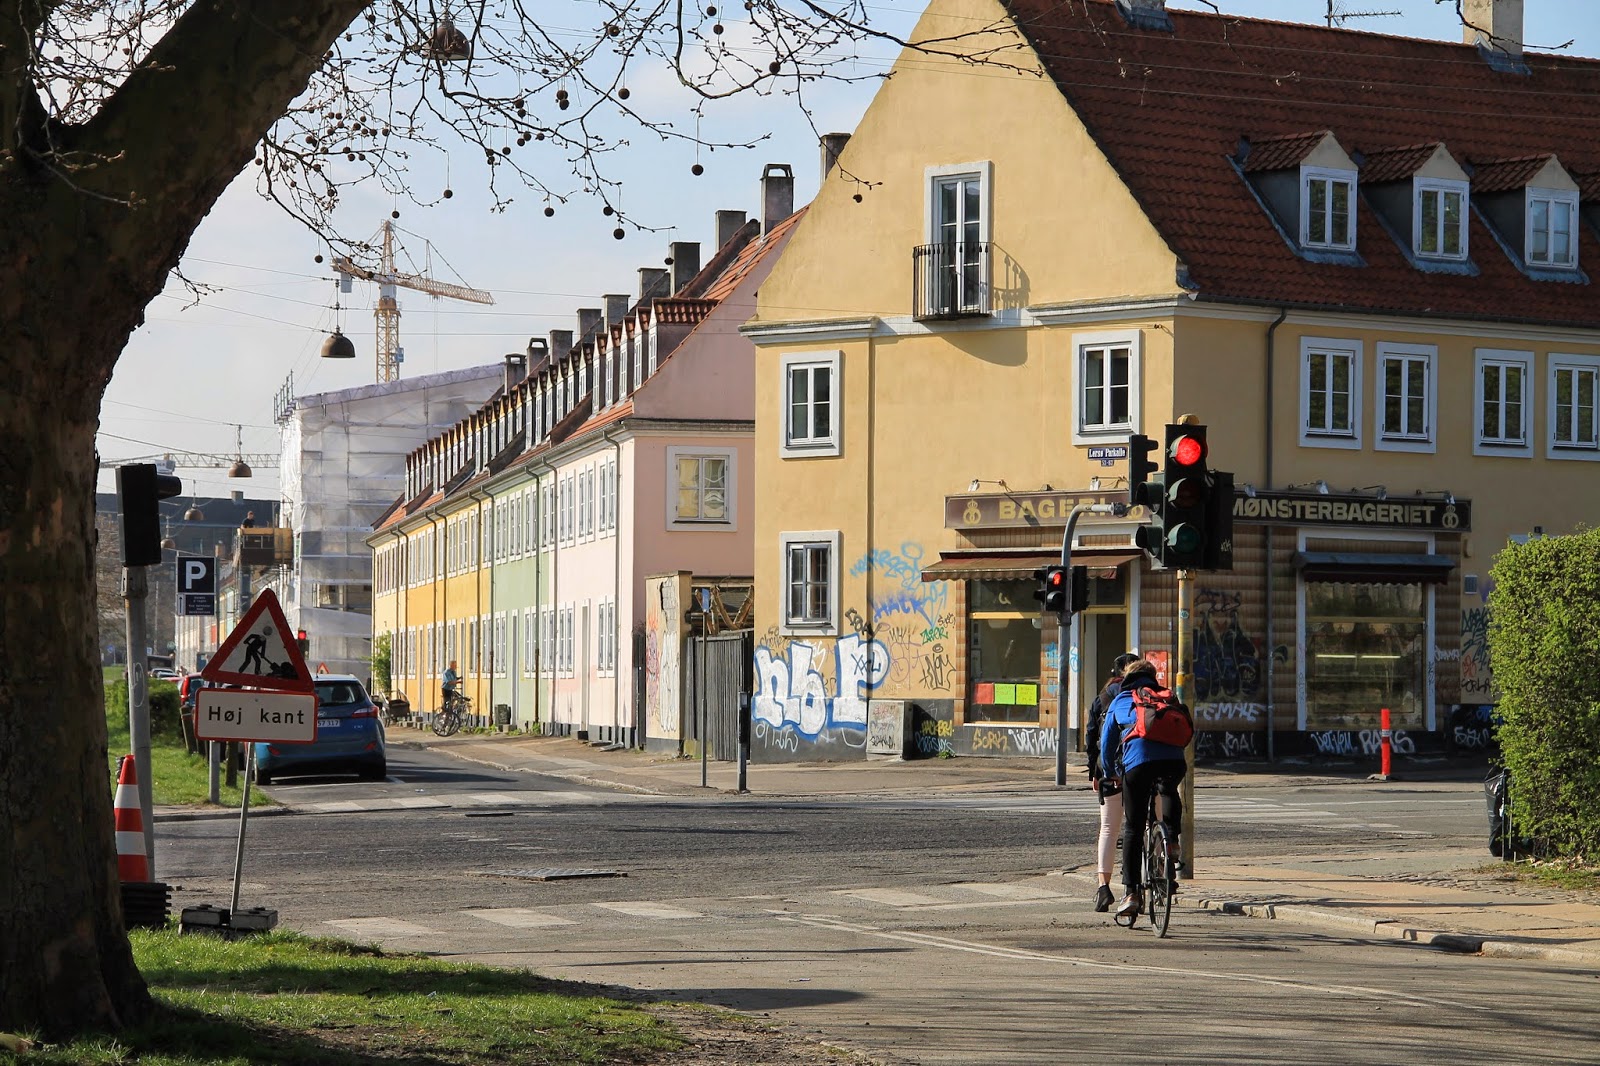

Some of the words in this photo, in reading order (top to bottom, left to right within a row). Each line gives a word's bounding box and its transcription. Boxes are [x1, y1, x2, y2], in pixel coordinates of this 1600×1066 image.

[1000, 498, 1106, 520] BAGERI
[185, 560, 207, 590] P
[208, 705, 242, 725] Høj
[260, 707, 305, 725] kant
